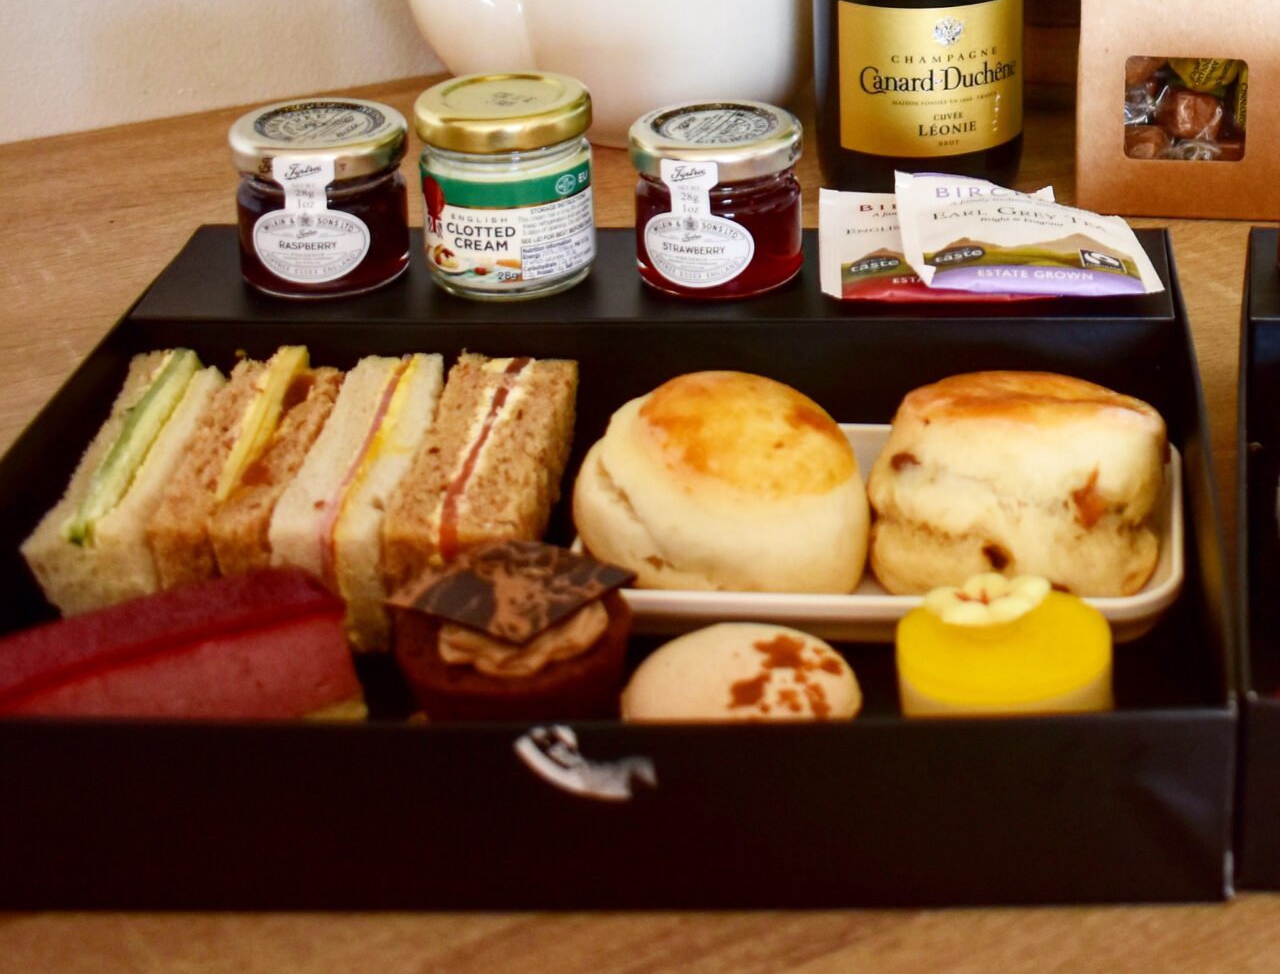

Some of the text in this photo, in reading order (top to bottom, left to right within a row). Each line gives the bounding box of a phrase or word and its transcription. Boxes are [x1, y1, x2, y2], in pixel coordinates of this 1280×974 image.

[891, 46, 998, 64] CHAMPAGNE
[859, 60, 1016, 95] Canard-Duchêne
[933, 111, 964, 121] CUVÉE
[918, 120, 977, 137] LÉONIE
[938, 139, 960, 147] BRUT
[295, 189, 315, 198] 28g
[680, 192, 700, 203] 28g
[317, 217, 339, 228] SONS
[451, 213, 509, 224] ENGLISH
[933, 208, 988, 221] EARL
[997, 206, 1056, 220] GREY
[1064, 214, 1107, 232] TEA
[446, 222, 517, 239] CLOTTED
[702, 221, 723, 234] SONS
[279, 240, 338, 251] RASPBERRY
[454, 237, 509, 252] CREAM
[662, 242, 726, 256] STRAWBERRY
[935, 248, 984, 263] taste
[851, 259, 899, 273] taste
[977, 268, 1093, 281] ESTATE GROWN
